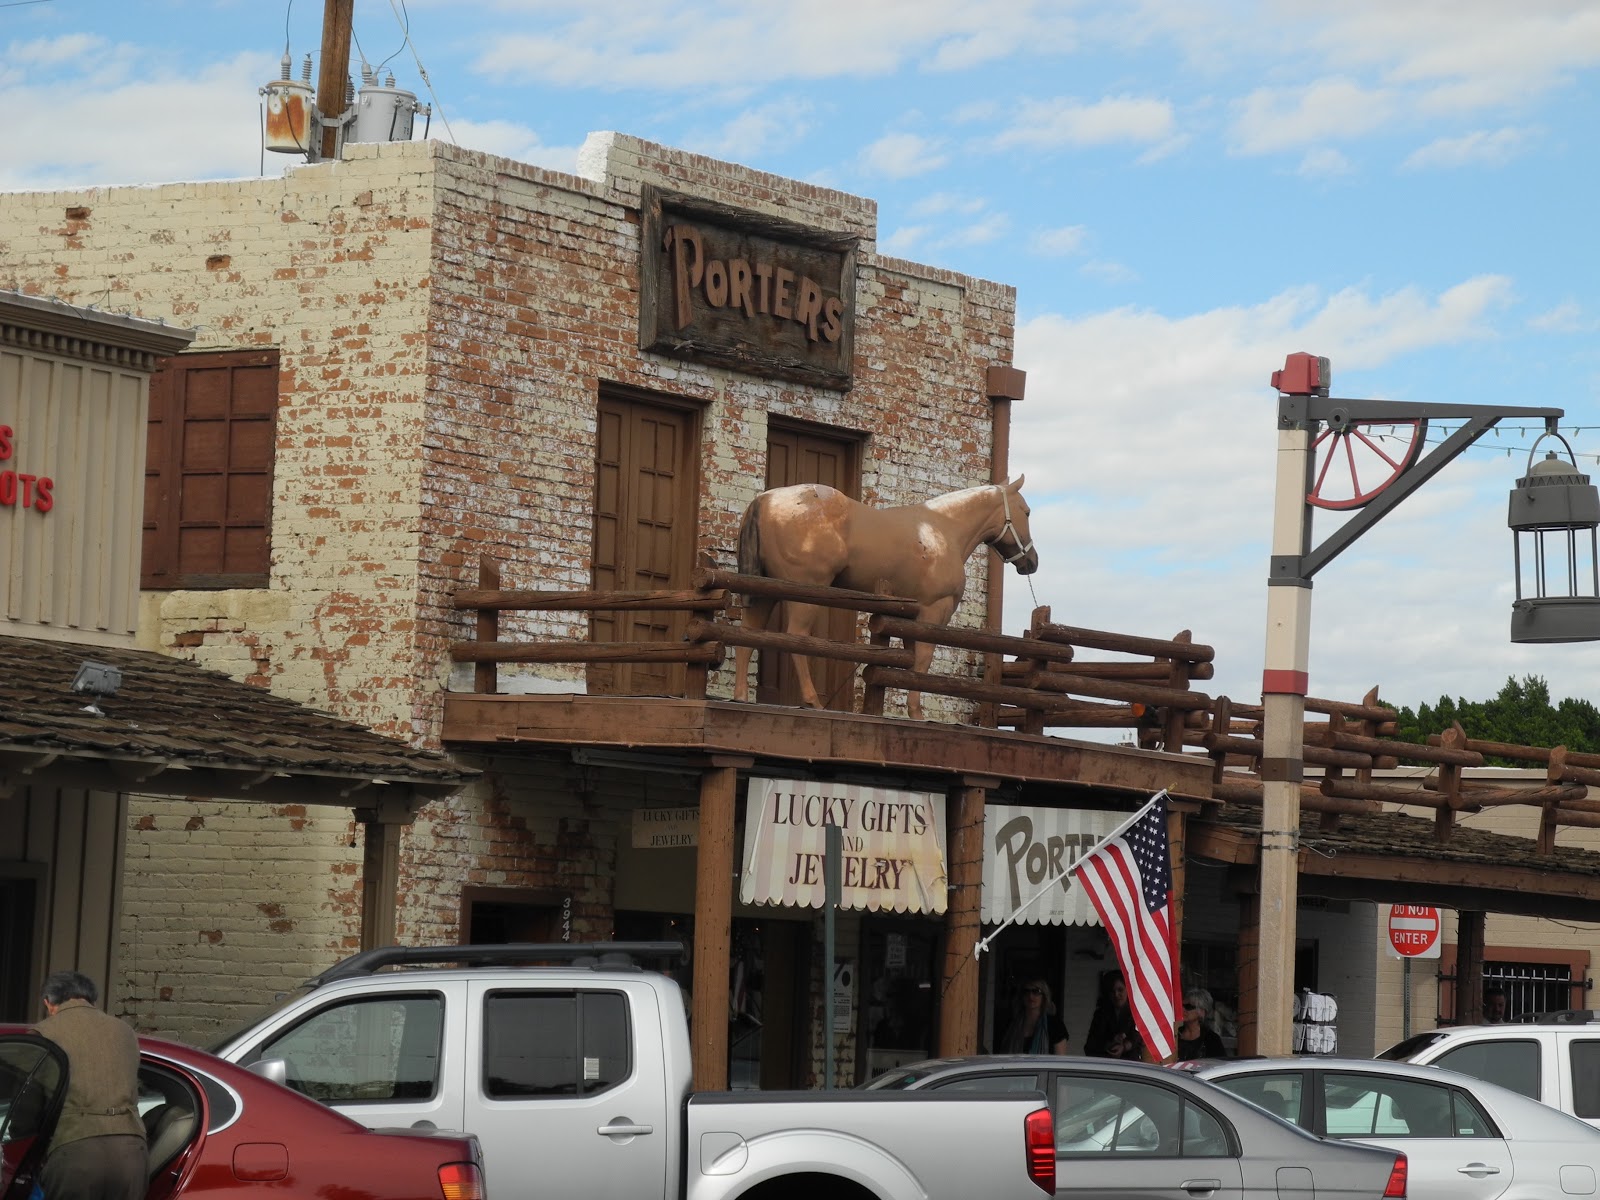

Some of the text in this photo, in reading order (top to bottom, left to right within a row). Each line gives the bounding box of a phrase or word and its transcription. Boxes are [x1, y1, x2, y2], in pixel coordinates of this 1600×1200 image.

[664, 224, 844, 342] PORTERS
[0, 470, 54, 512] OTS
[643, 810, 671, 822] LUCKY
[772, 792, 929, 837] LUCKY GIFTS
[650, 834, 693, 846] JEWELRY
[789, 852, 908, 890] JEELRY
[995, 816, 1107, 914] PORT
[562, 897, 571, 941] 3944
[1394, 904, 1429, 916] DO NOT
[1394, 932, 1428, 944] ENTER
